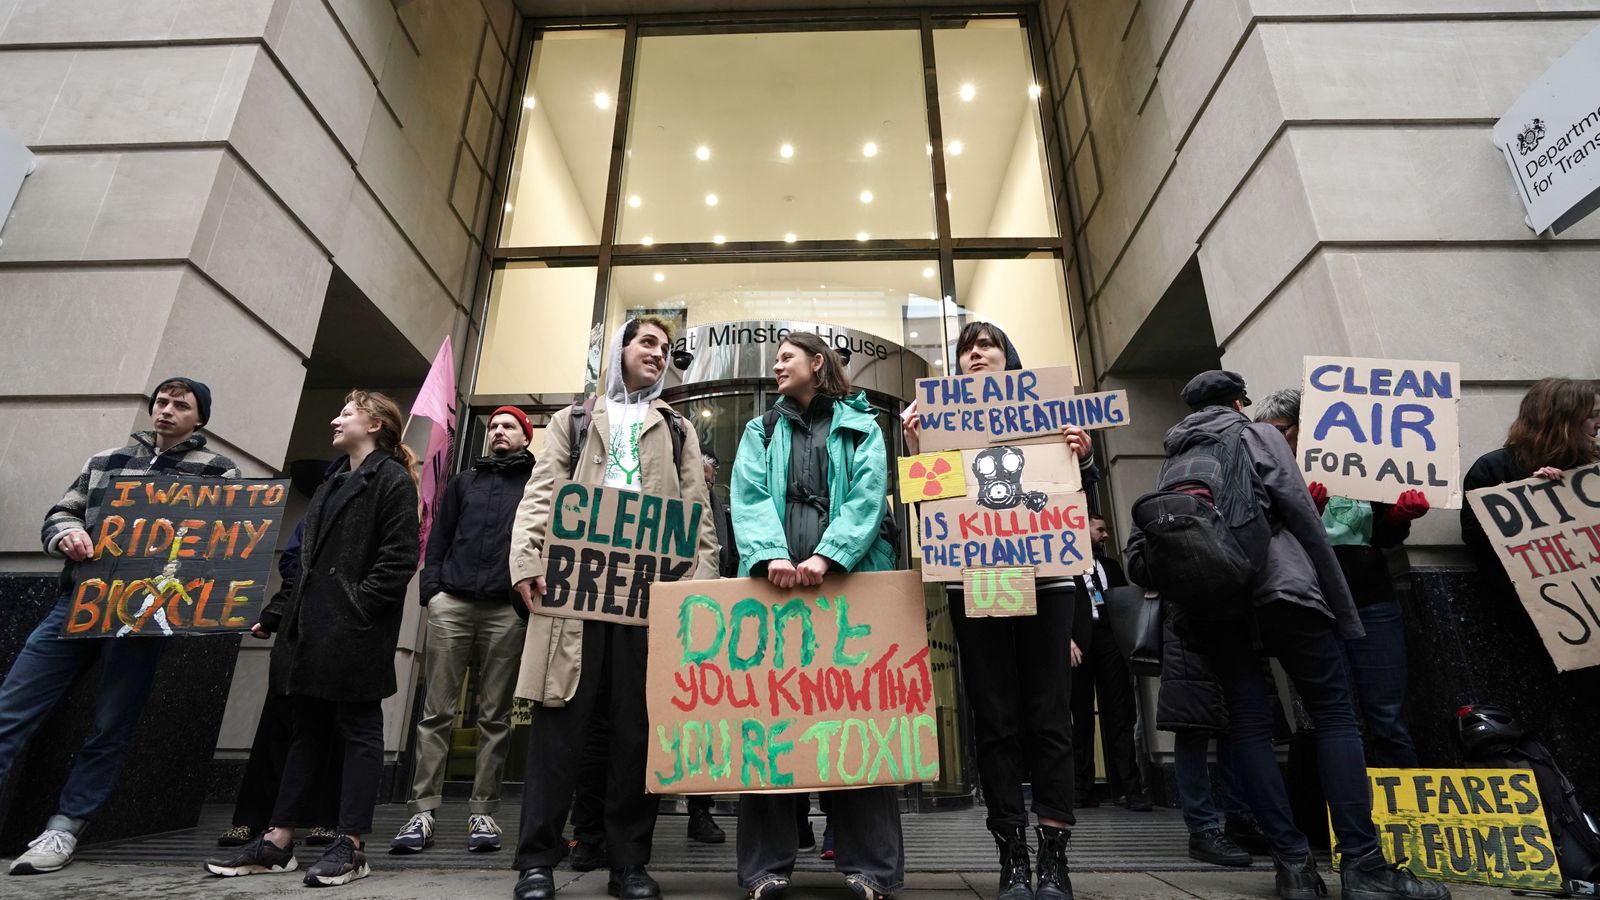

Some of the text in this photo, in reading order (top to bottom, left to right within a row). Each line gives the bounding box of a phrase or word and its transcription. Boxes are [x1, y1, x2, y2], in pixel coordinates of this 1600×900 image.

[1525, 105, 1600, 178] Departm
[1532, 172, 1553, 197] for
[708, 324, 797, 348] Minste
[815, 325, 888, 361] House
[919, 371, 1039, 406] THE AIR
[1309, 364, 1453, 399] CLEAN
[919, 394, 1124, 436] WE'RE BREATHING
[1313, 401, 1436, 451] AIR
[1304, 447, 1448, 487] FOR ALL
[110, 481, 284, 508] I WANT TO
[94, 515, 273, 560] RIDE MY
[552, 483, 703, 558] CLEAN
[923, 505, 1086, 541] IS KILLING
[921, 530, 1084, 568] THE PLANET &
[1505, 530, 1586, 579] THE
[66, 578, 256, 634] BICYCLE
[971, 570, 1024, 613] US
[671, 643, 933, 716] YOU KNOW THAT
[799, 714, 940, 785] TOXIC
[1413, 774, 1540, 814] FARES
[1420, 824, 1556, 873] FUMES
